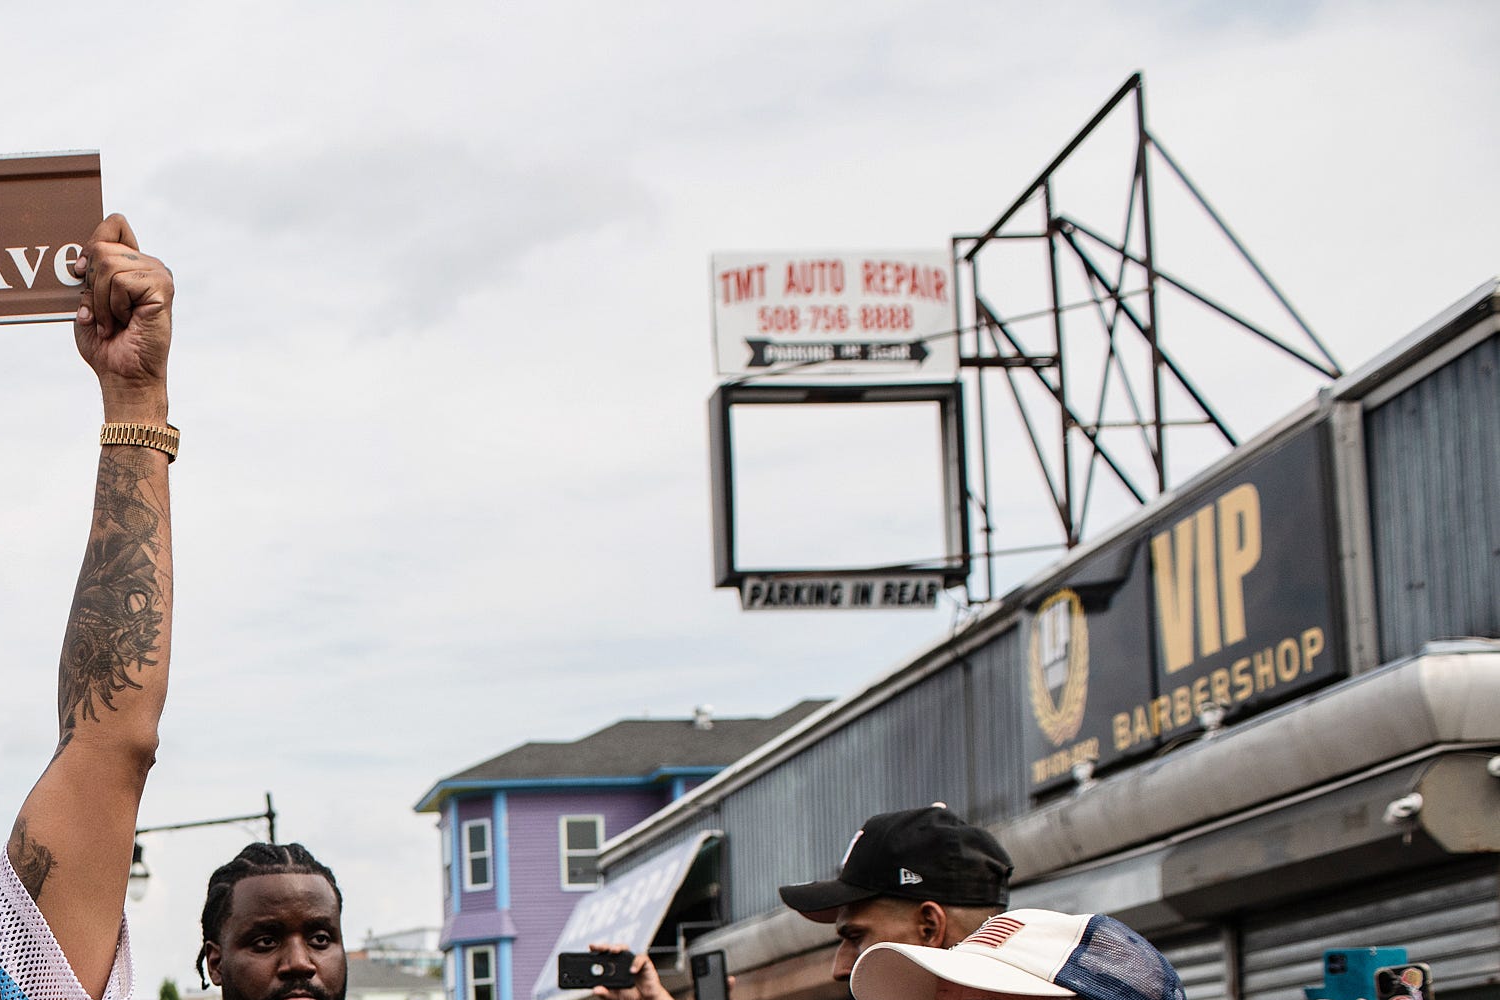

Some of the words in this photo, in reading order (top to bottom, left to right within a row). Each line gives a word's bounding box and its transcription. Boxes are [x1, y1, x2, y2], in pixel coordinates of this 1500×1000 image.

[721, 263, 768, 304] TMT
[783, 259, 845, 295] AUTO
[861, 260, 949, 302] REPAIR
[749, 579, 844, 607] PARKING
[851, 581, 874, 605] IN
[881, 579, 938, 606] REAR
[1150, 483, 1263, 675] VIP
[1112, 626, 1325, 751] BARBERSHOP
